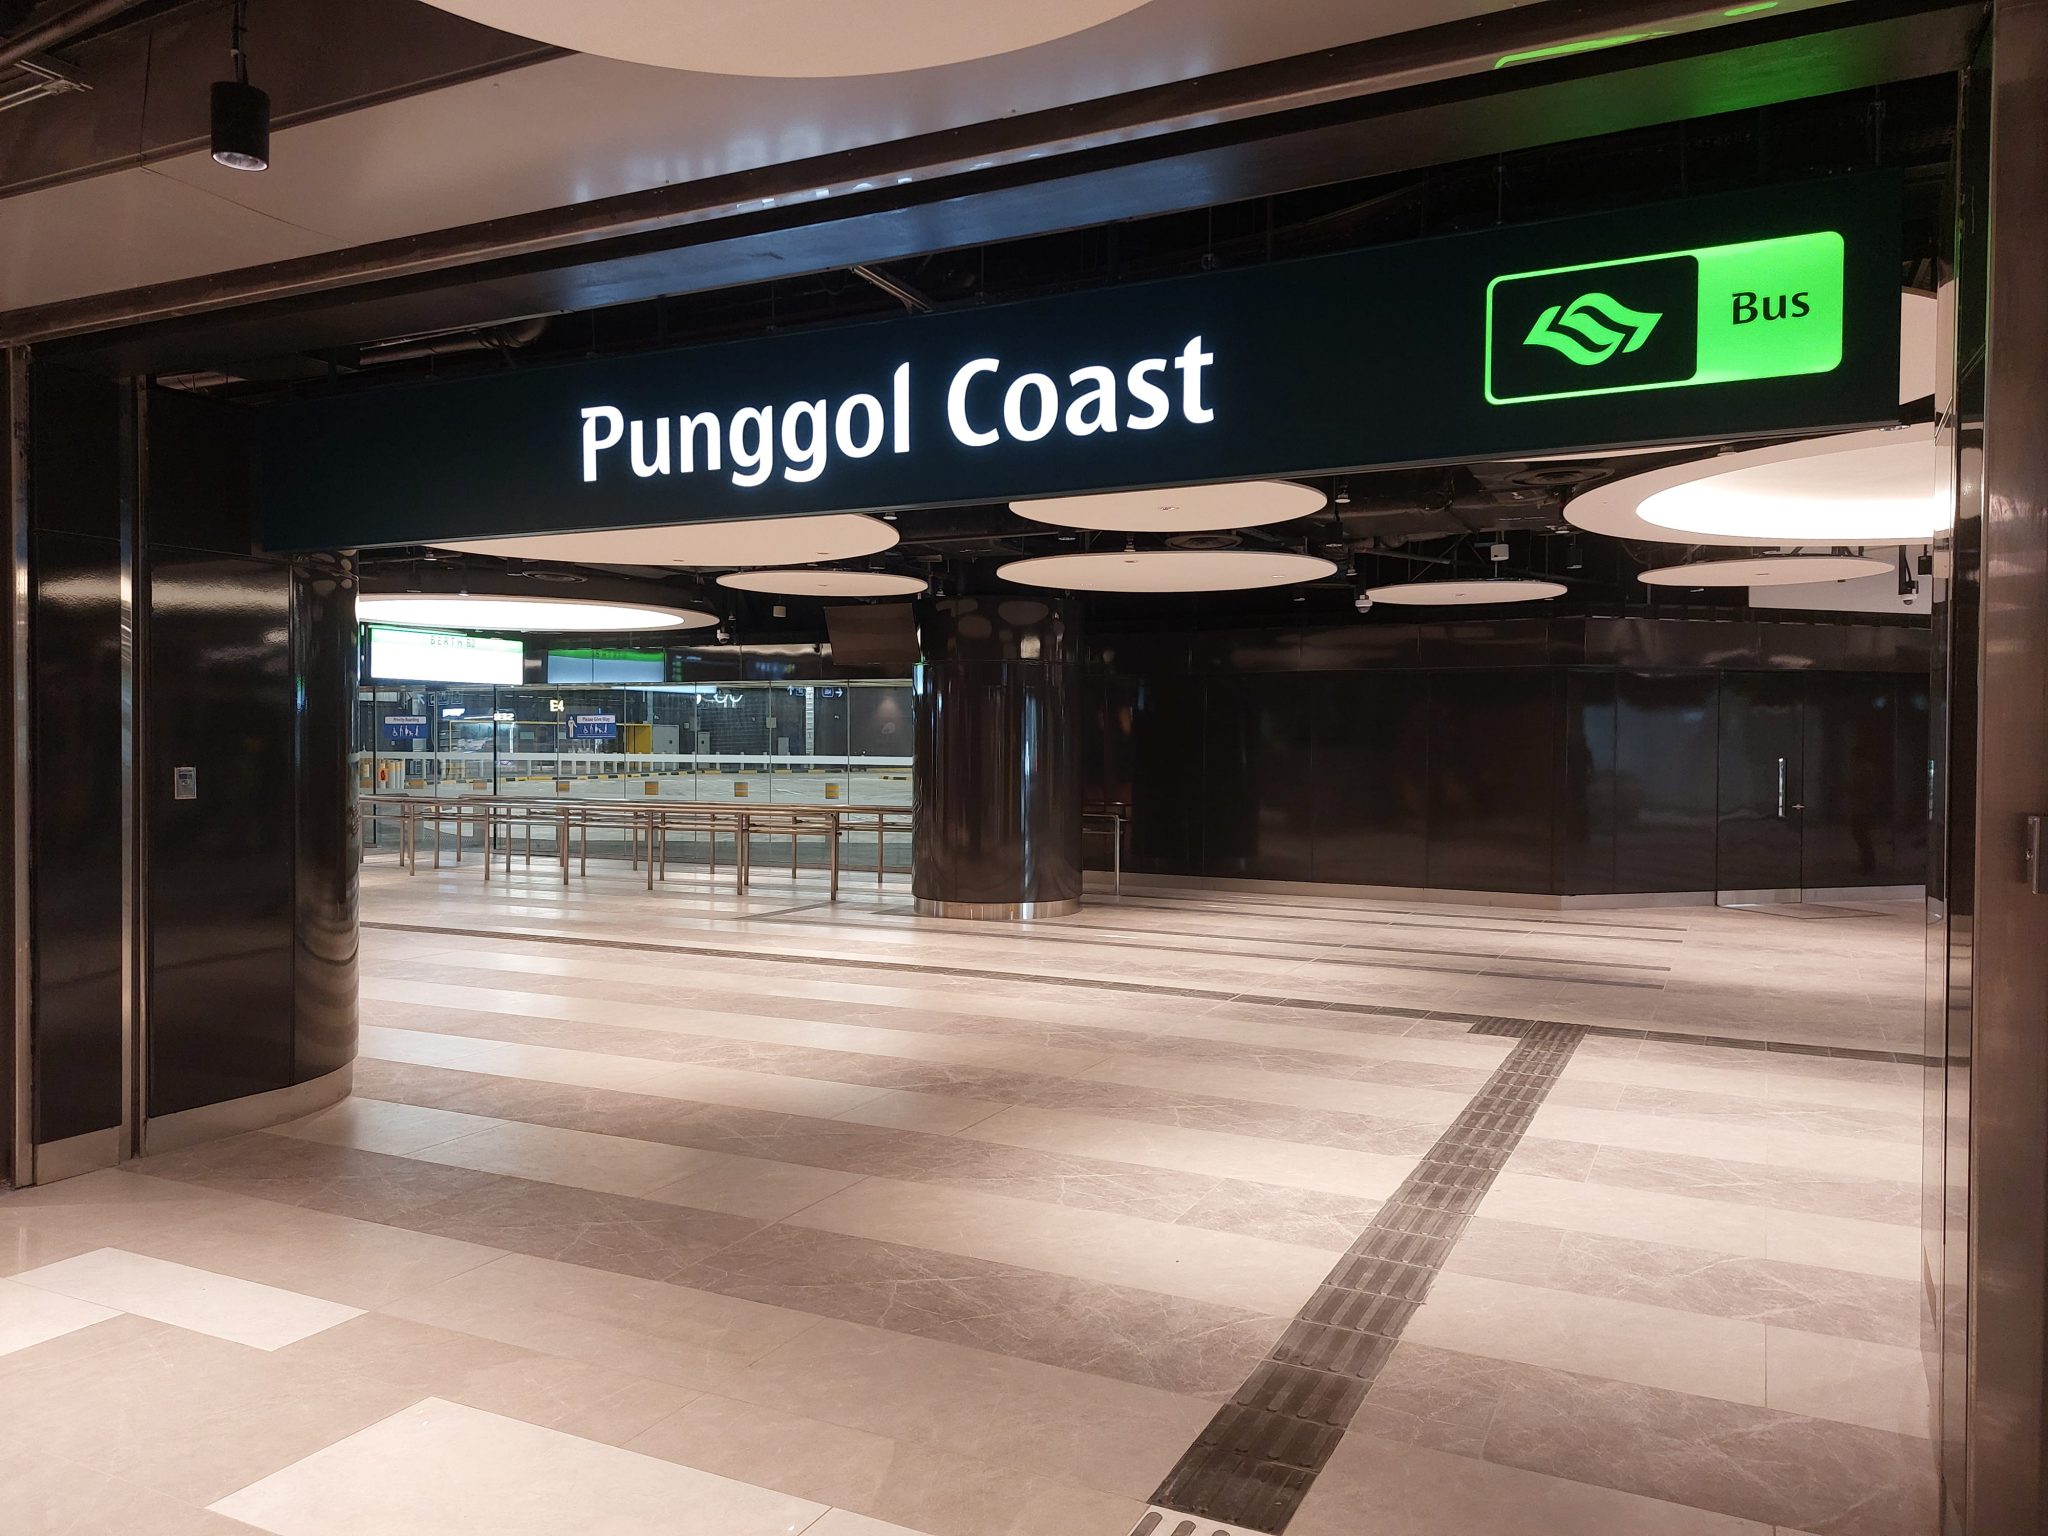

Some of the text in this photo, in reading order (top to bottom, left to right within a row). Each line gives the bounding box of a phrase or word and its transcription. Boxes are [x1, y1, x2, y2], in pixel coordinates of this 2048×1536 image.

[1731, 291, 1811, 325] Bus
[579, 335, 1216, 488] Punggol Coast
[549, 699, 565, 712] E4
